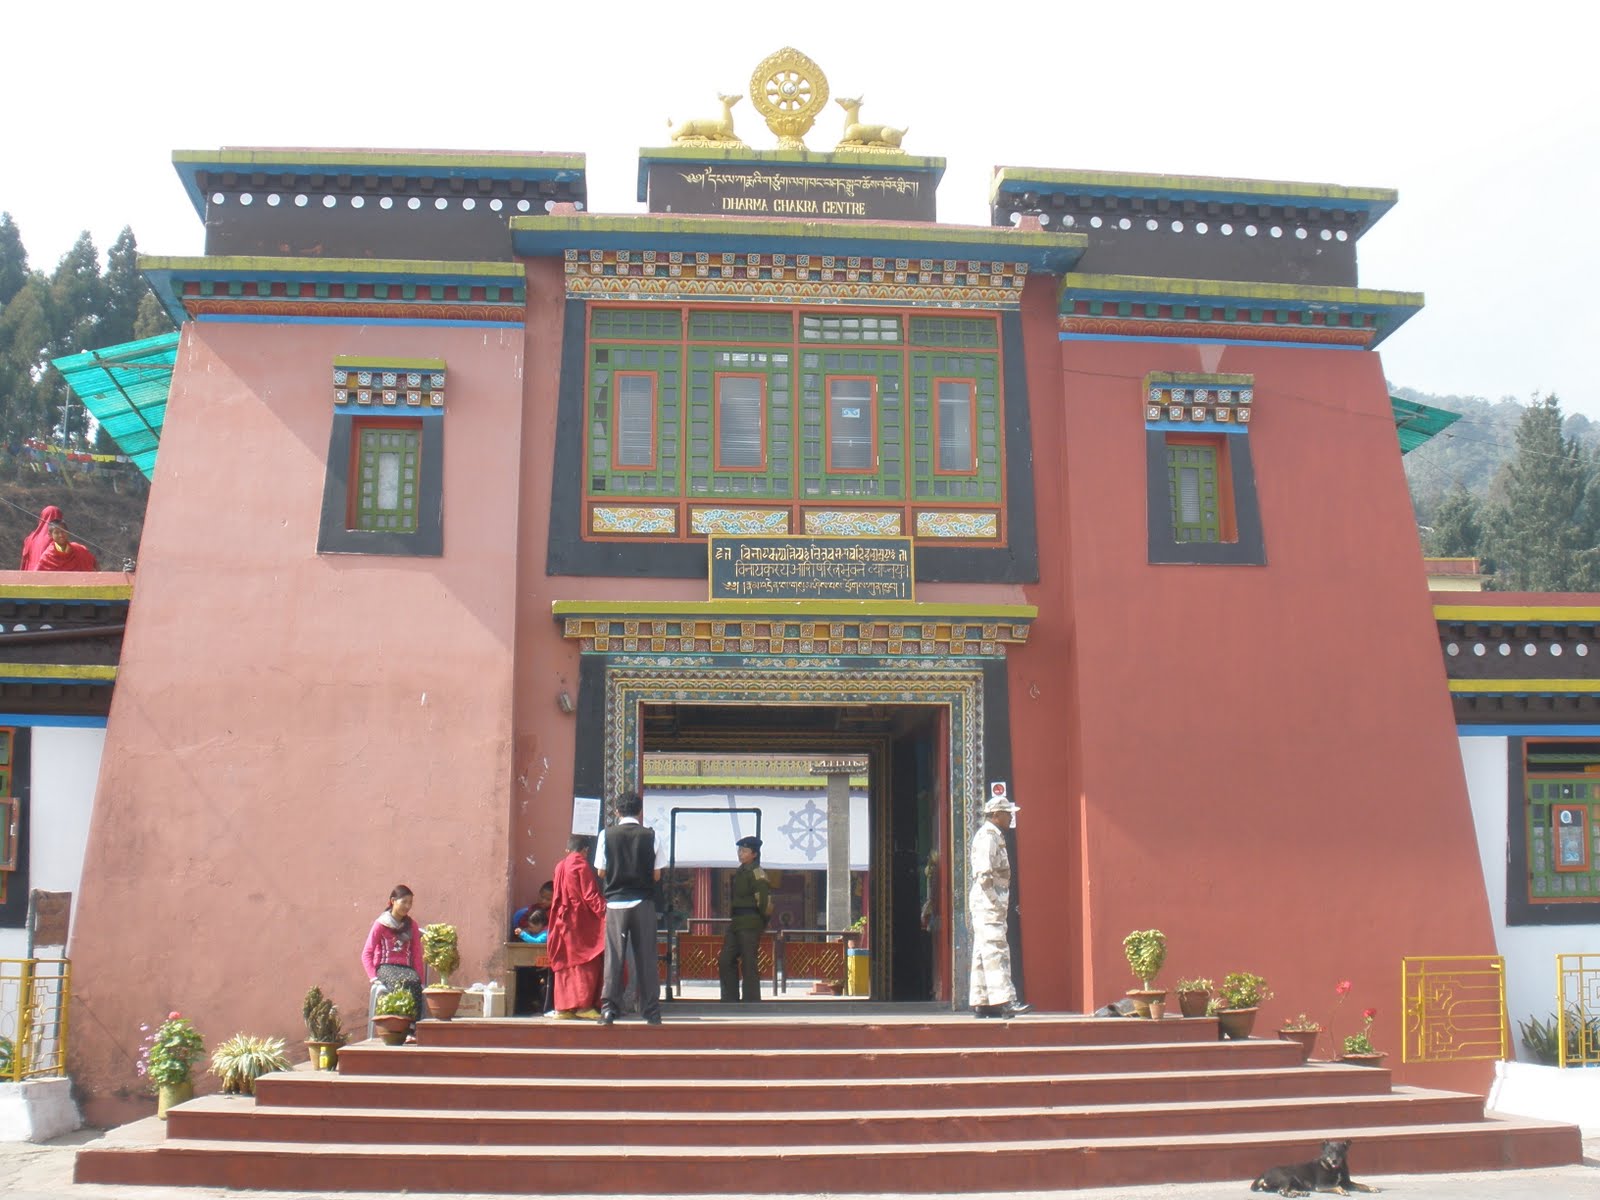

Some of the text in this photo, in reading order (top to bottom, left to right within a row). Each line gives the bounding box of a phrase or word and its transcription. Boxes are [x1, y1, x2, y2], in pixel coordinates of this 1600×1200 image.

[722, 197, 866, 215] DHARMA CHAKRA CENTRE
